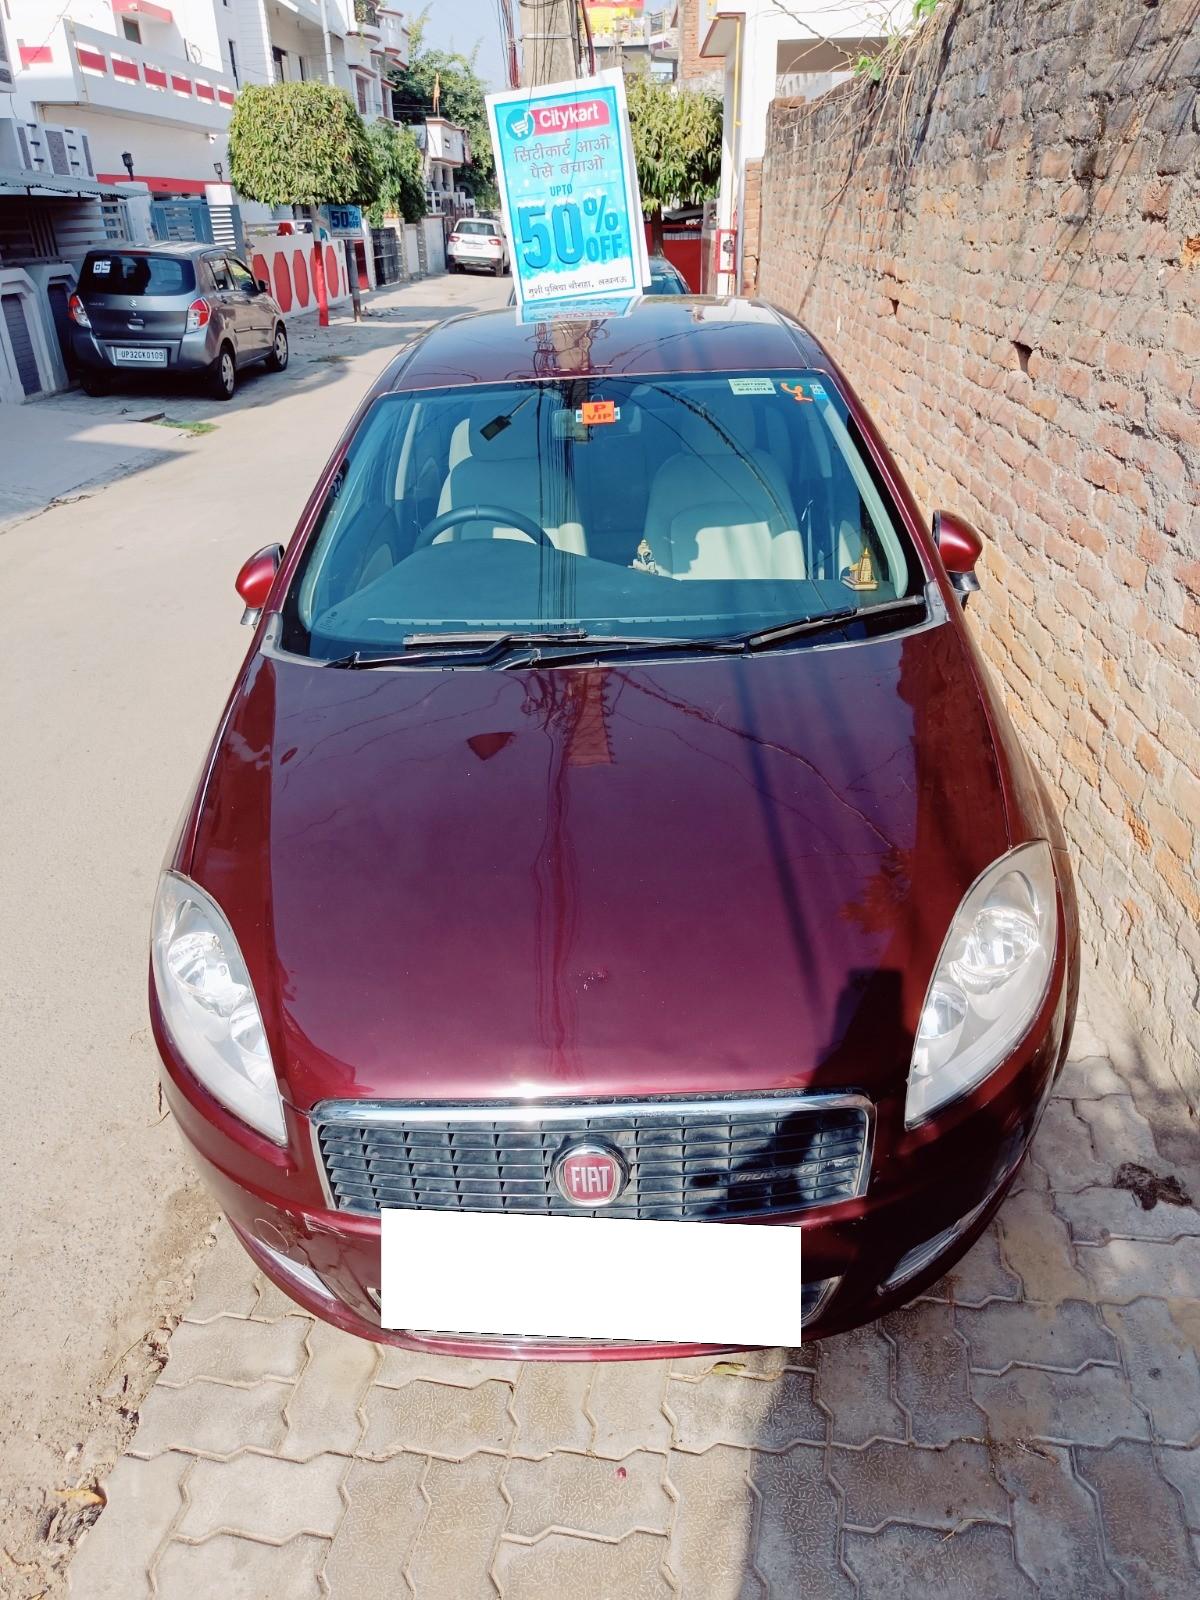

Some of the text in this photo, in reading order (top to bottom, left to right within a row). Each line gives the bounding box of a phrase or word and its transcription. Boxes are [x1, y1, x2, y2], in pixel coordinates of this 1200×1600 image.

[539, 103, 600, 130] Citykart
[514, 134, 611, 162] सिटीकार्ट आओ
[530, 154, 606, 178] पैसे बचाओ
[549, 183, 573, 197] UPTO
[586, 233, 622, 262] OFF
[593, 404, 607, 413] P
[570, 1166, 611, 1193] FIAT
